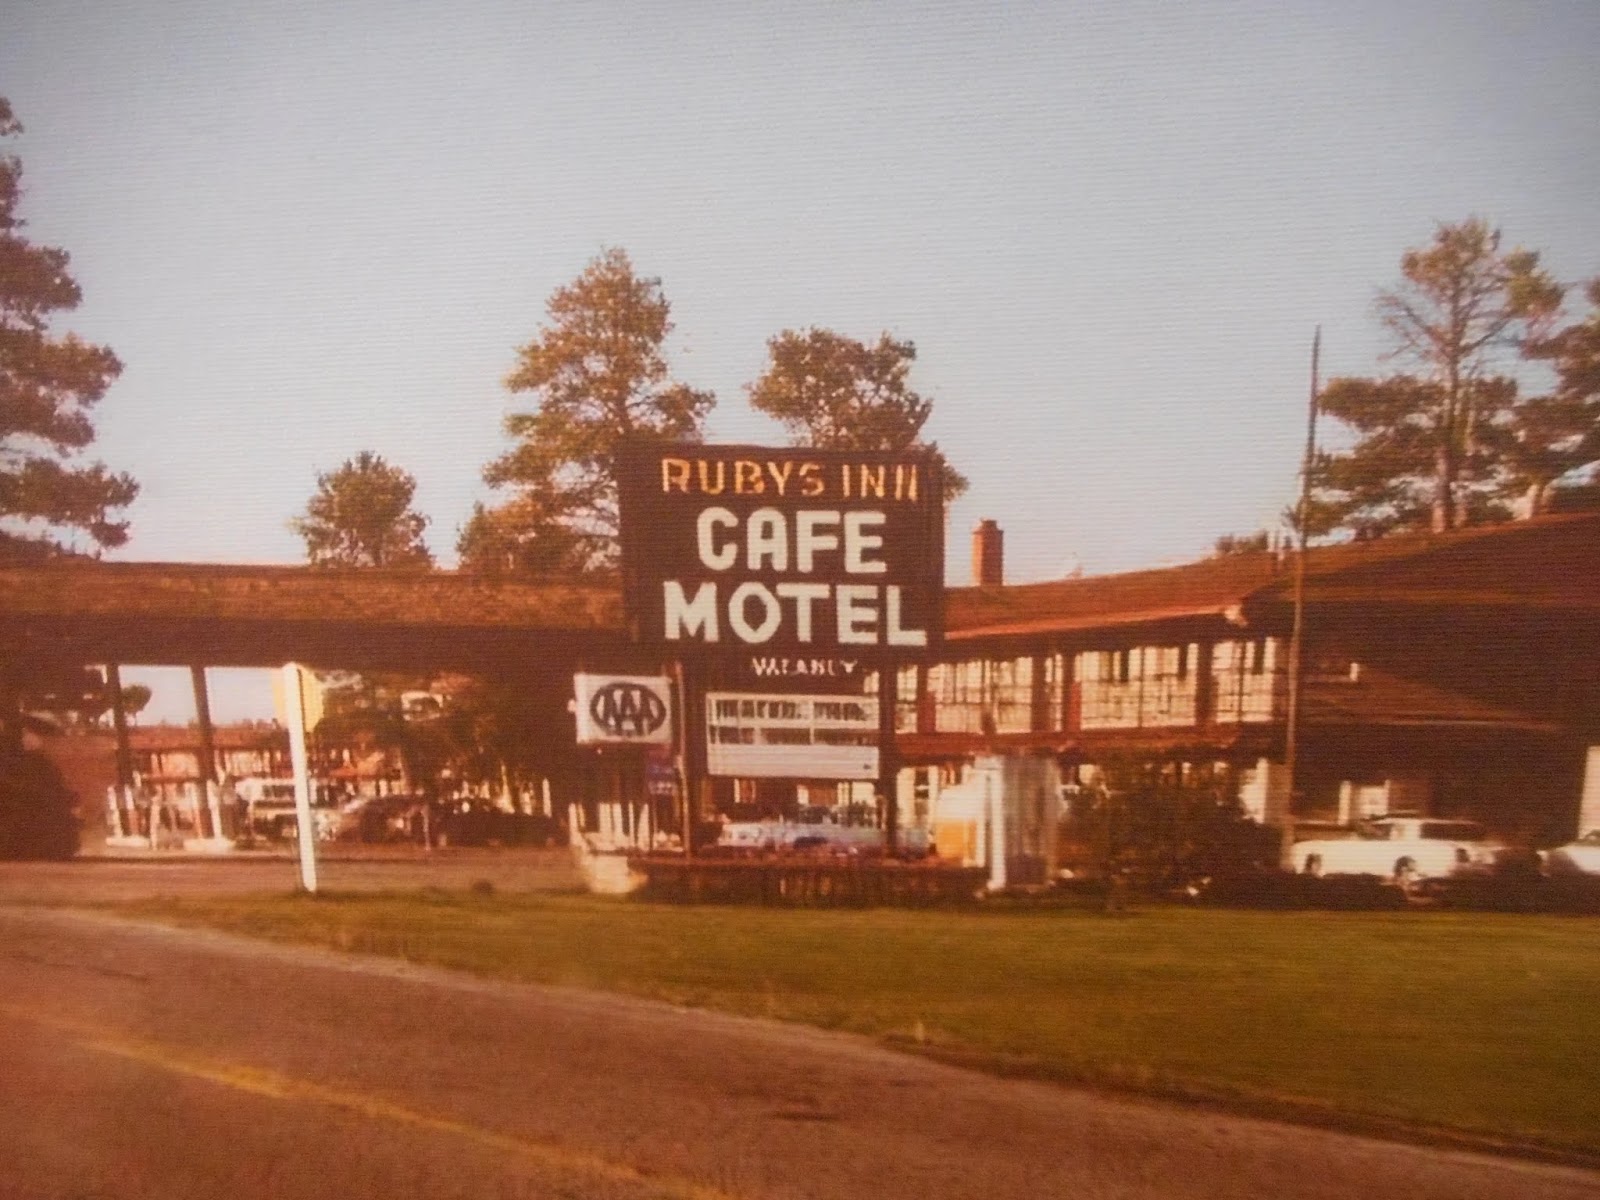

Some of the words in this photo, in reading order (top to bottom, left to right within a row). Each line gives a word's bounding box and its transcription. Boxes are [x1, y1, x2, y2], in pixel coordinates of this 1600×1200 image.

[661, 458, 825, 497] RUBYS
[697, 506, 887, 573] CAFE
[662, 580, 928, 647] MOTEL
[592, 685, 665, 736] AAA
